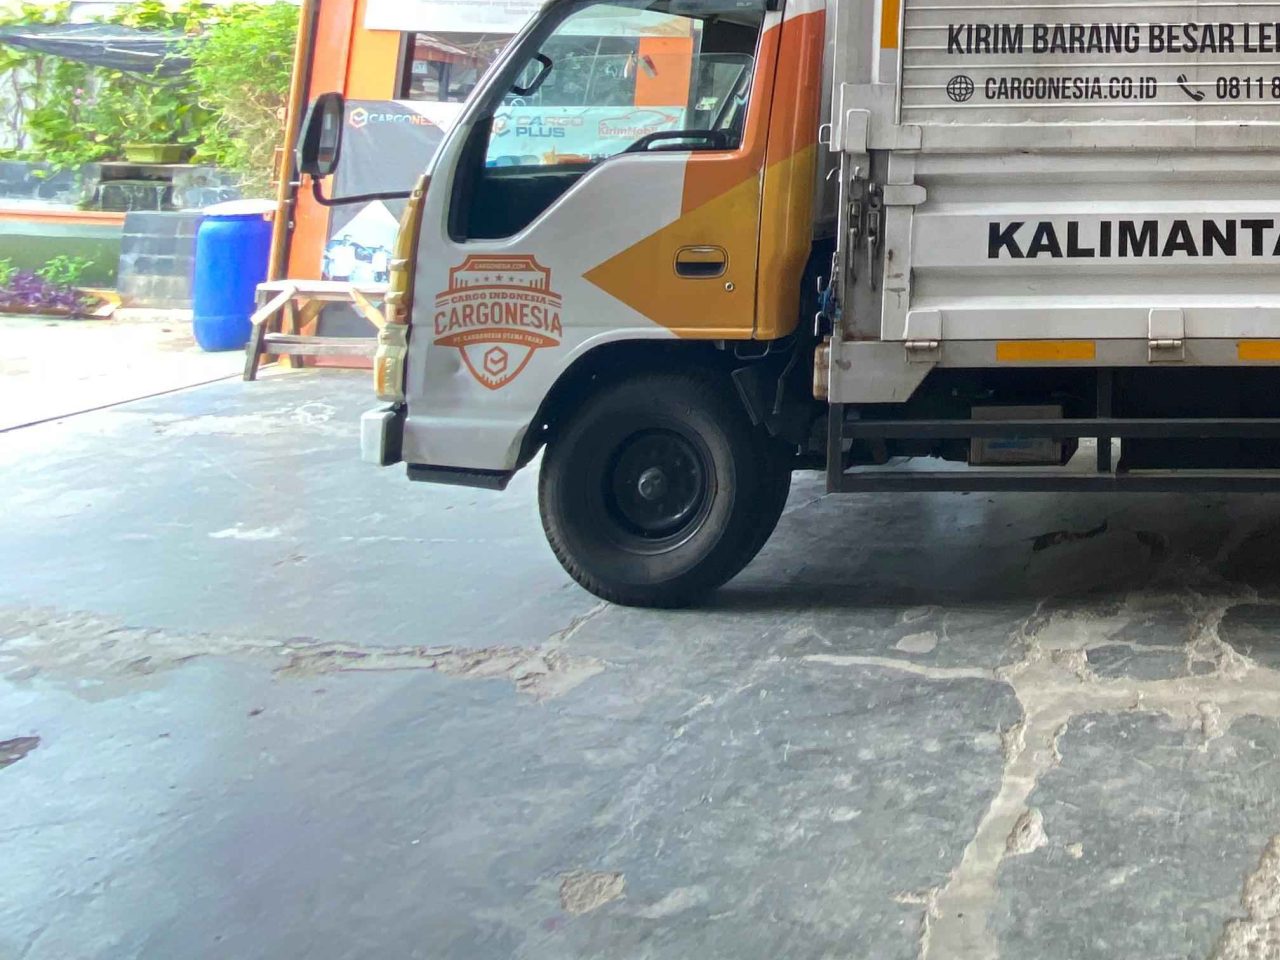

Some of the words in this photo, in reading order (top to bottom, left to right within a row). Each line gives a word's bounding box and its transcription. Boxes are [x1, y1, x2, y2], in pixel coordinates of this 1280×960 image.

[947, 23, 1024, 54] KIRIM
[1032, 23, 1140, 54] BARANG
[1148, 22, 1235, 53] BESAR
[984, 76, 1157, 100] CARGONESIA.CO.ID
[1216, 76, 1264, 99] 0811
[515, 126, 566, 138] PLUS
[516, 115, 584, 126] CARGO
[451, 292, 487, 303] CARGO
[489, 291, 547, 304] INDONESIA
[434, 301, 563, 337] CARGONESIA
